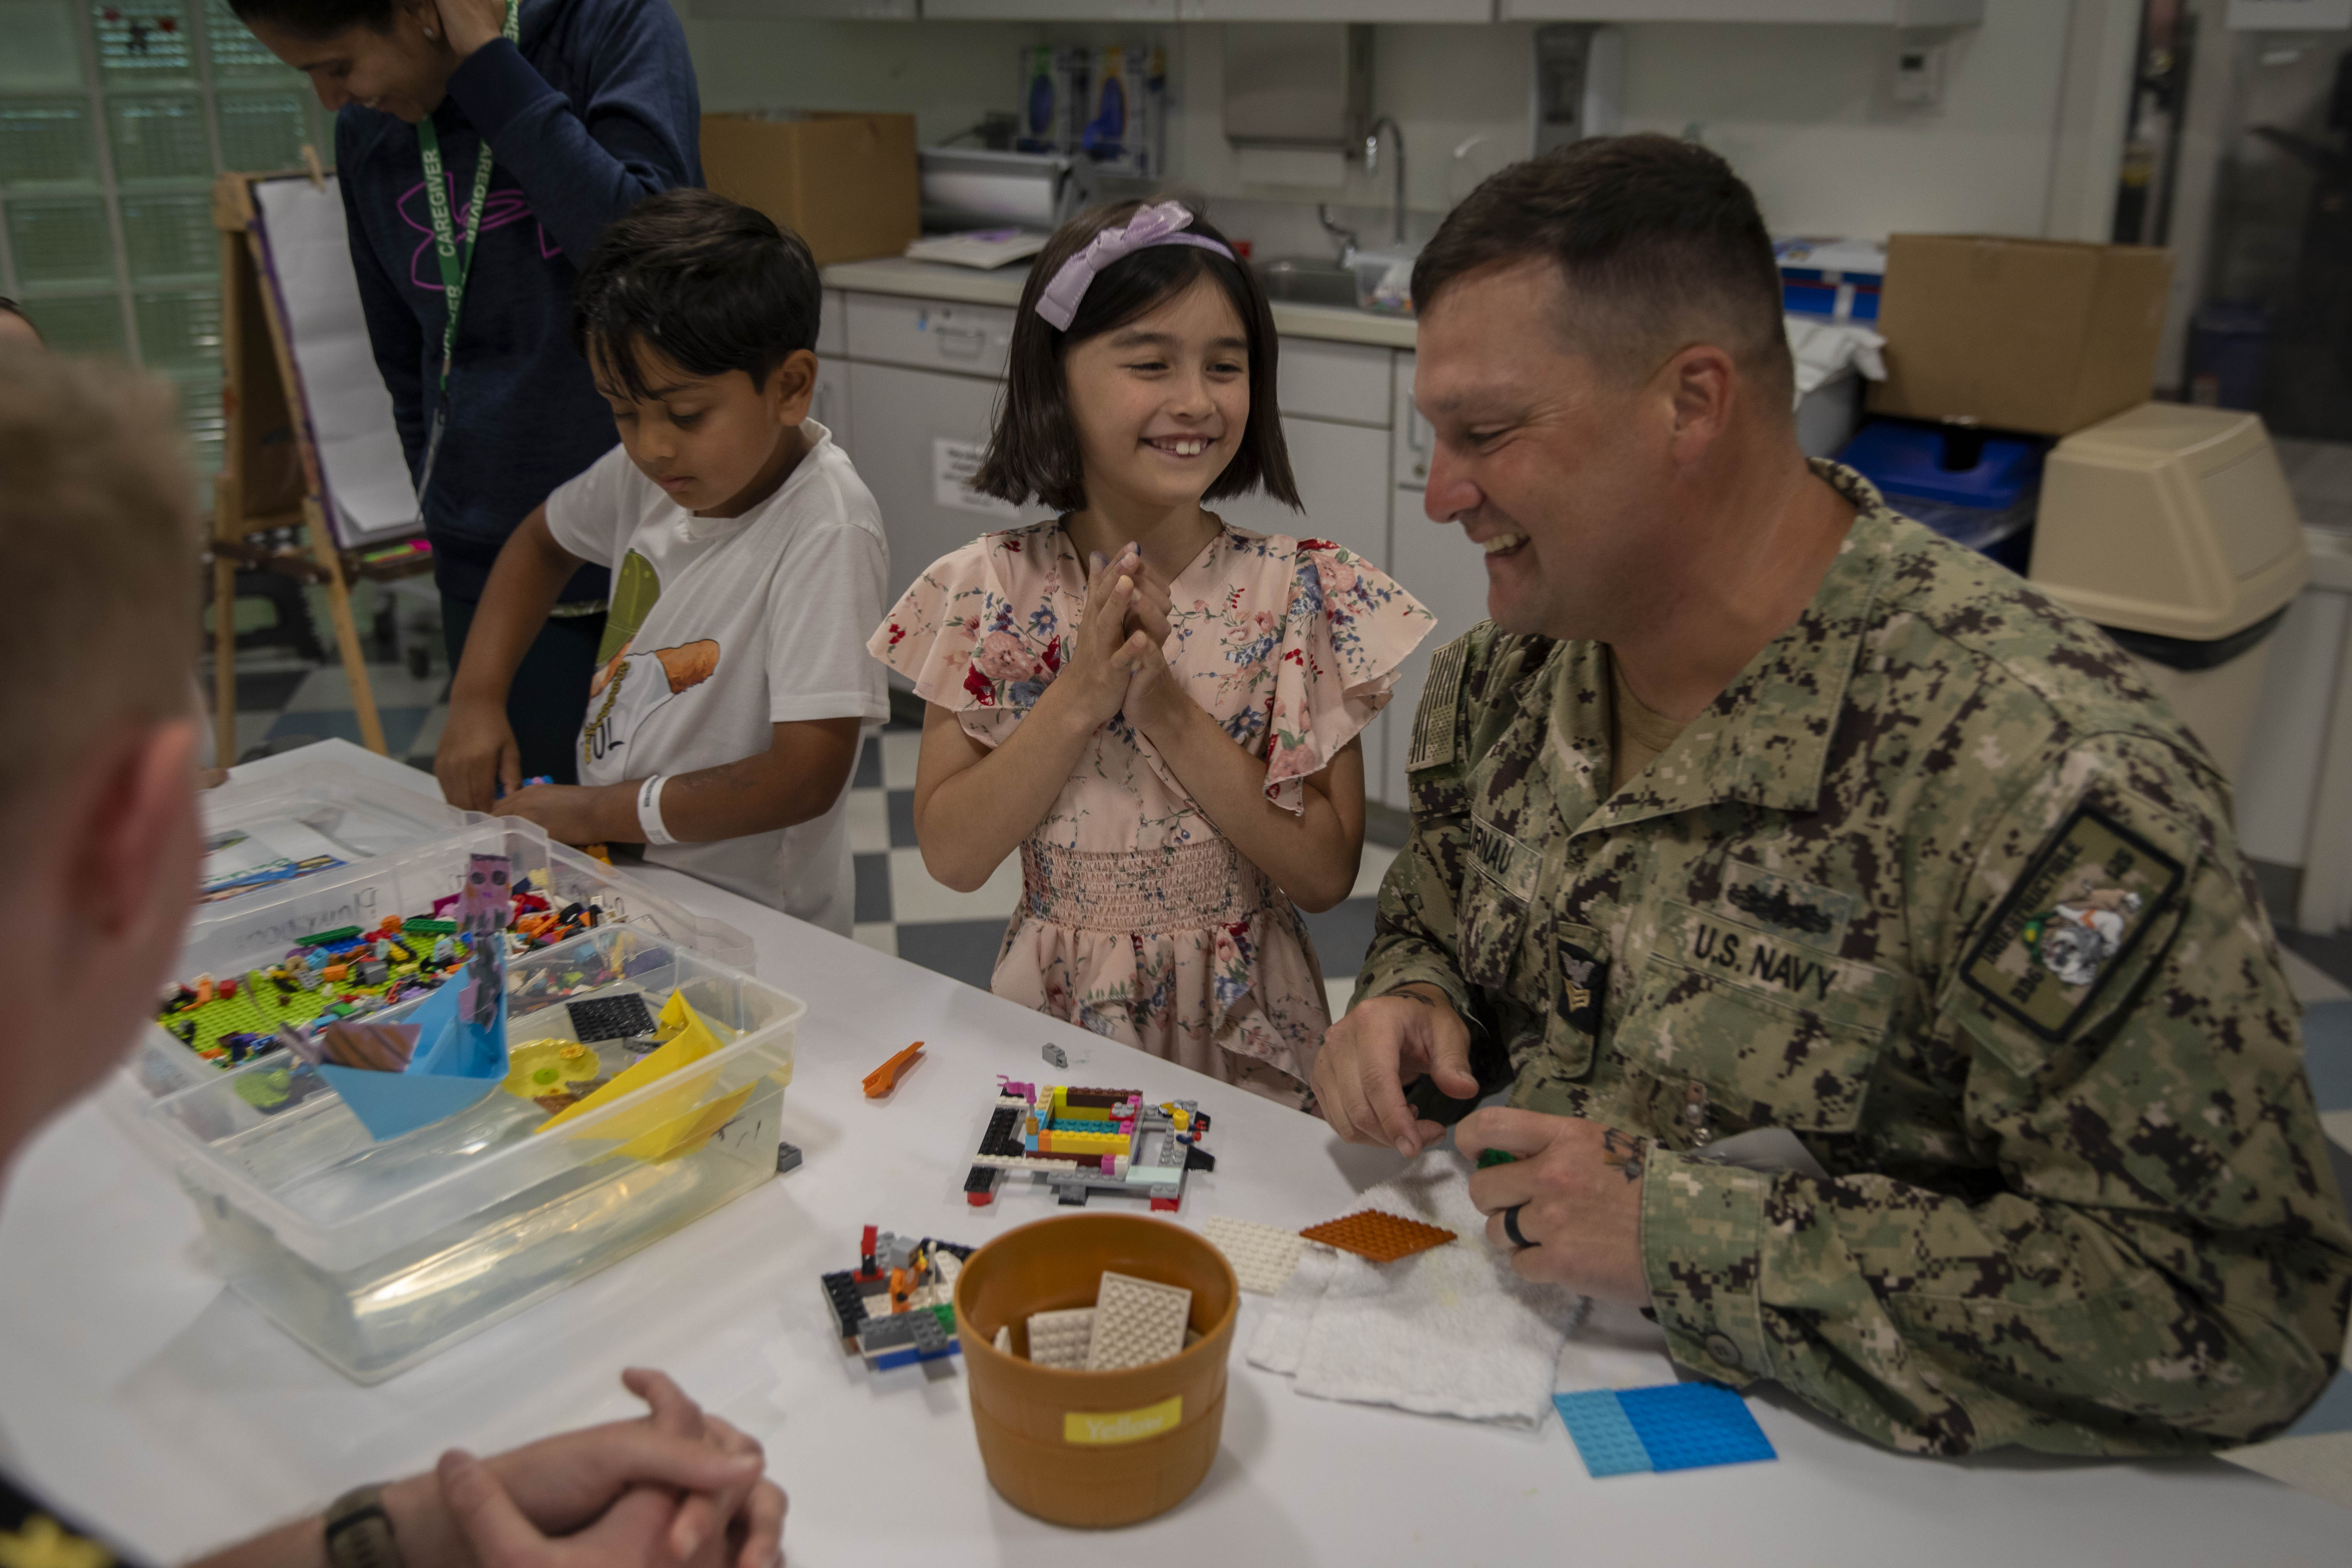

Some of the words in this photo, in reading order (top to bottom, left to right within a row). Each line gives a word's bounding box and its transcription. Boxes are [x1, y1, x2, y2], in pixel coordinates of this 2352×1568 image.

[422, 148, 456, 257] CAREGIVER
[466, 141, 493, 244] AREGIVER
[1695, 924, 1740, 971] U.S.
[1749, 944, 1838, 1001] NAVY
[1086, 1414, 1163, 1441] Yellow
